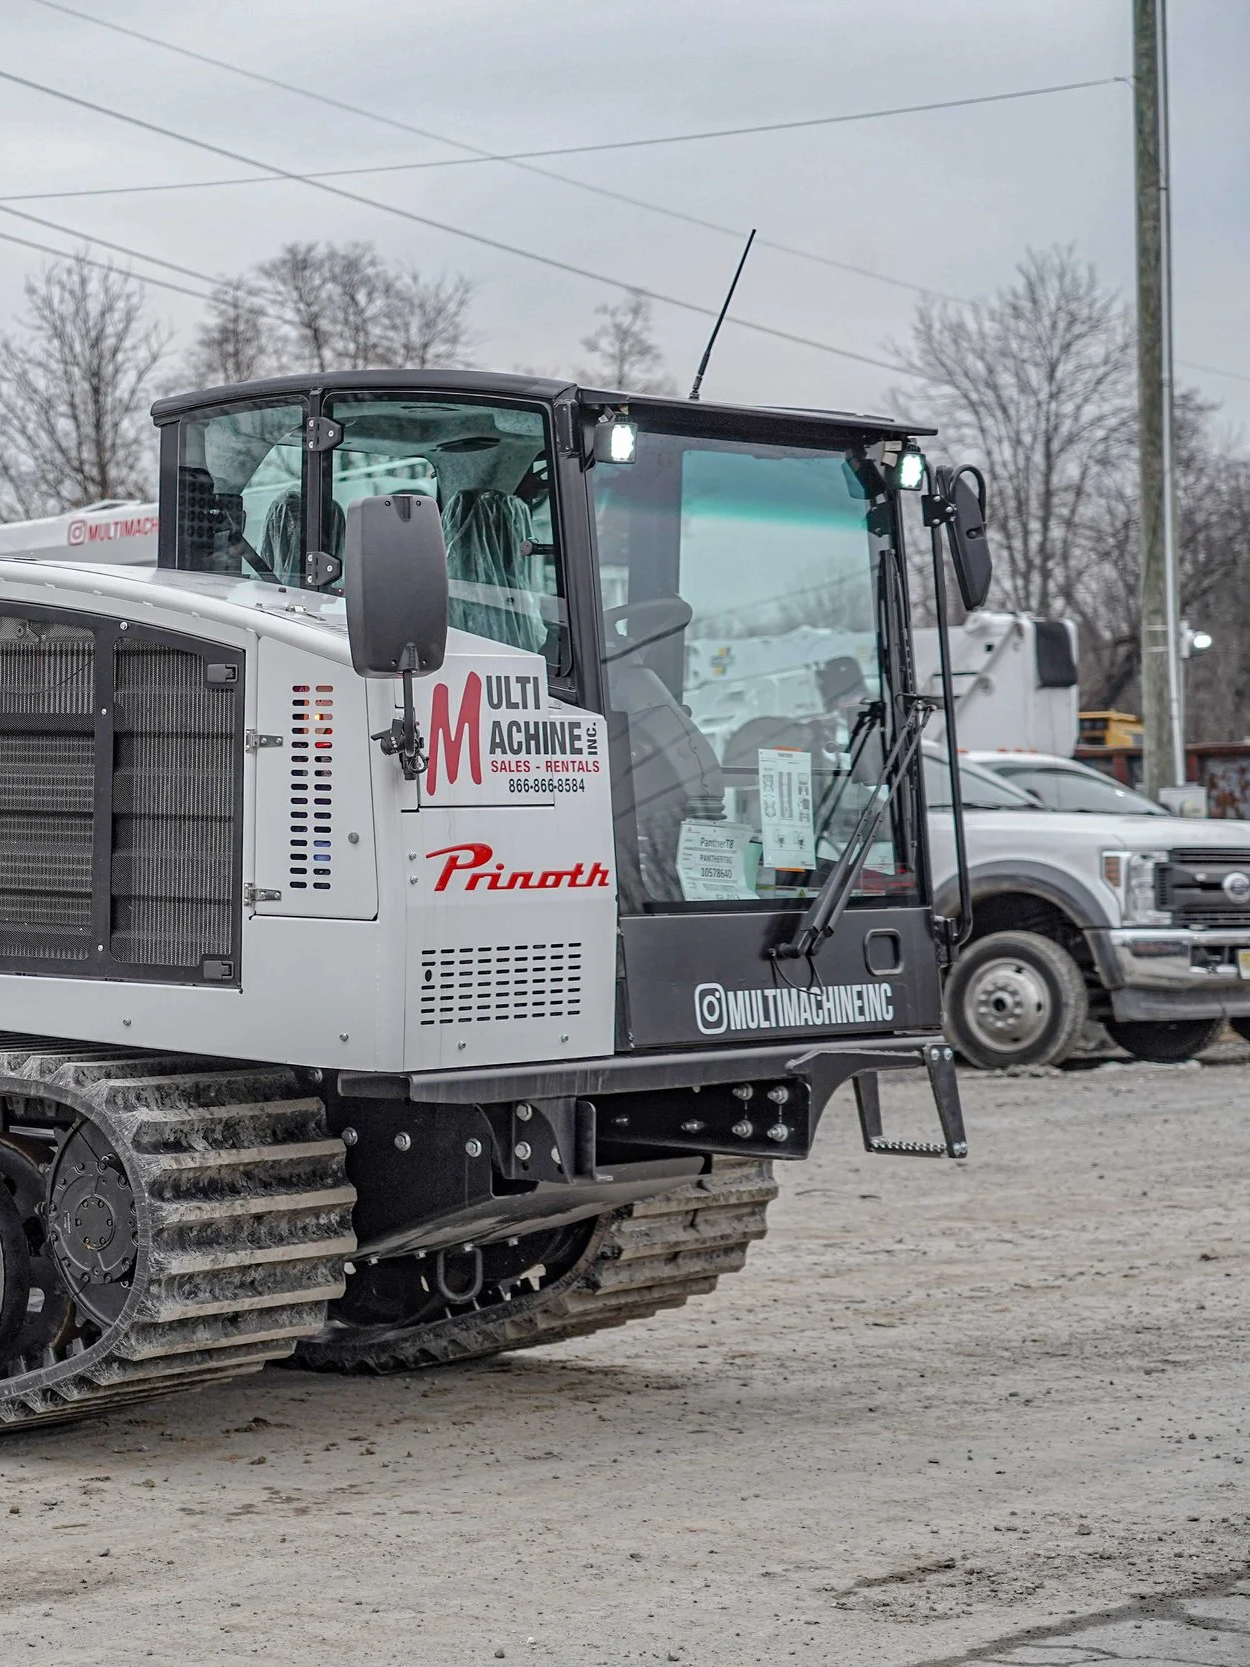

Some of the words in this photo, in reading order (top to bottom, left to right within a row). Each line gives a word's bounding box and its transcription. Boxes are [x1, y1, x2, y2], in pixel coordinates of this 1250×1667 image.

[586, 722, 598, 756] INC.
[491, 760, 531, 772] SALES
[545, 760, 600, 773] RENTALS
[508, 778, 585, 793] 866-866-8584
[426, 842, 609, 892] Prinoth
[727, 982, 894, 1030] MULTIMACHINEINC
